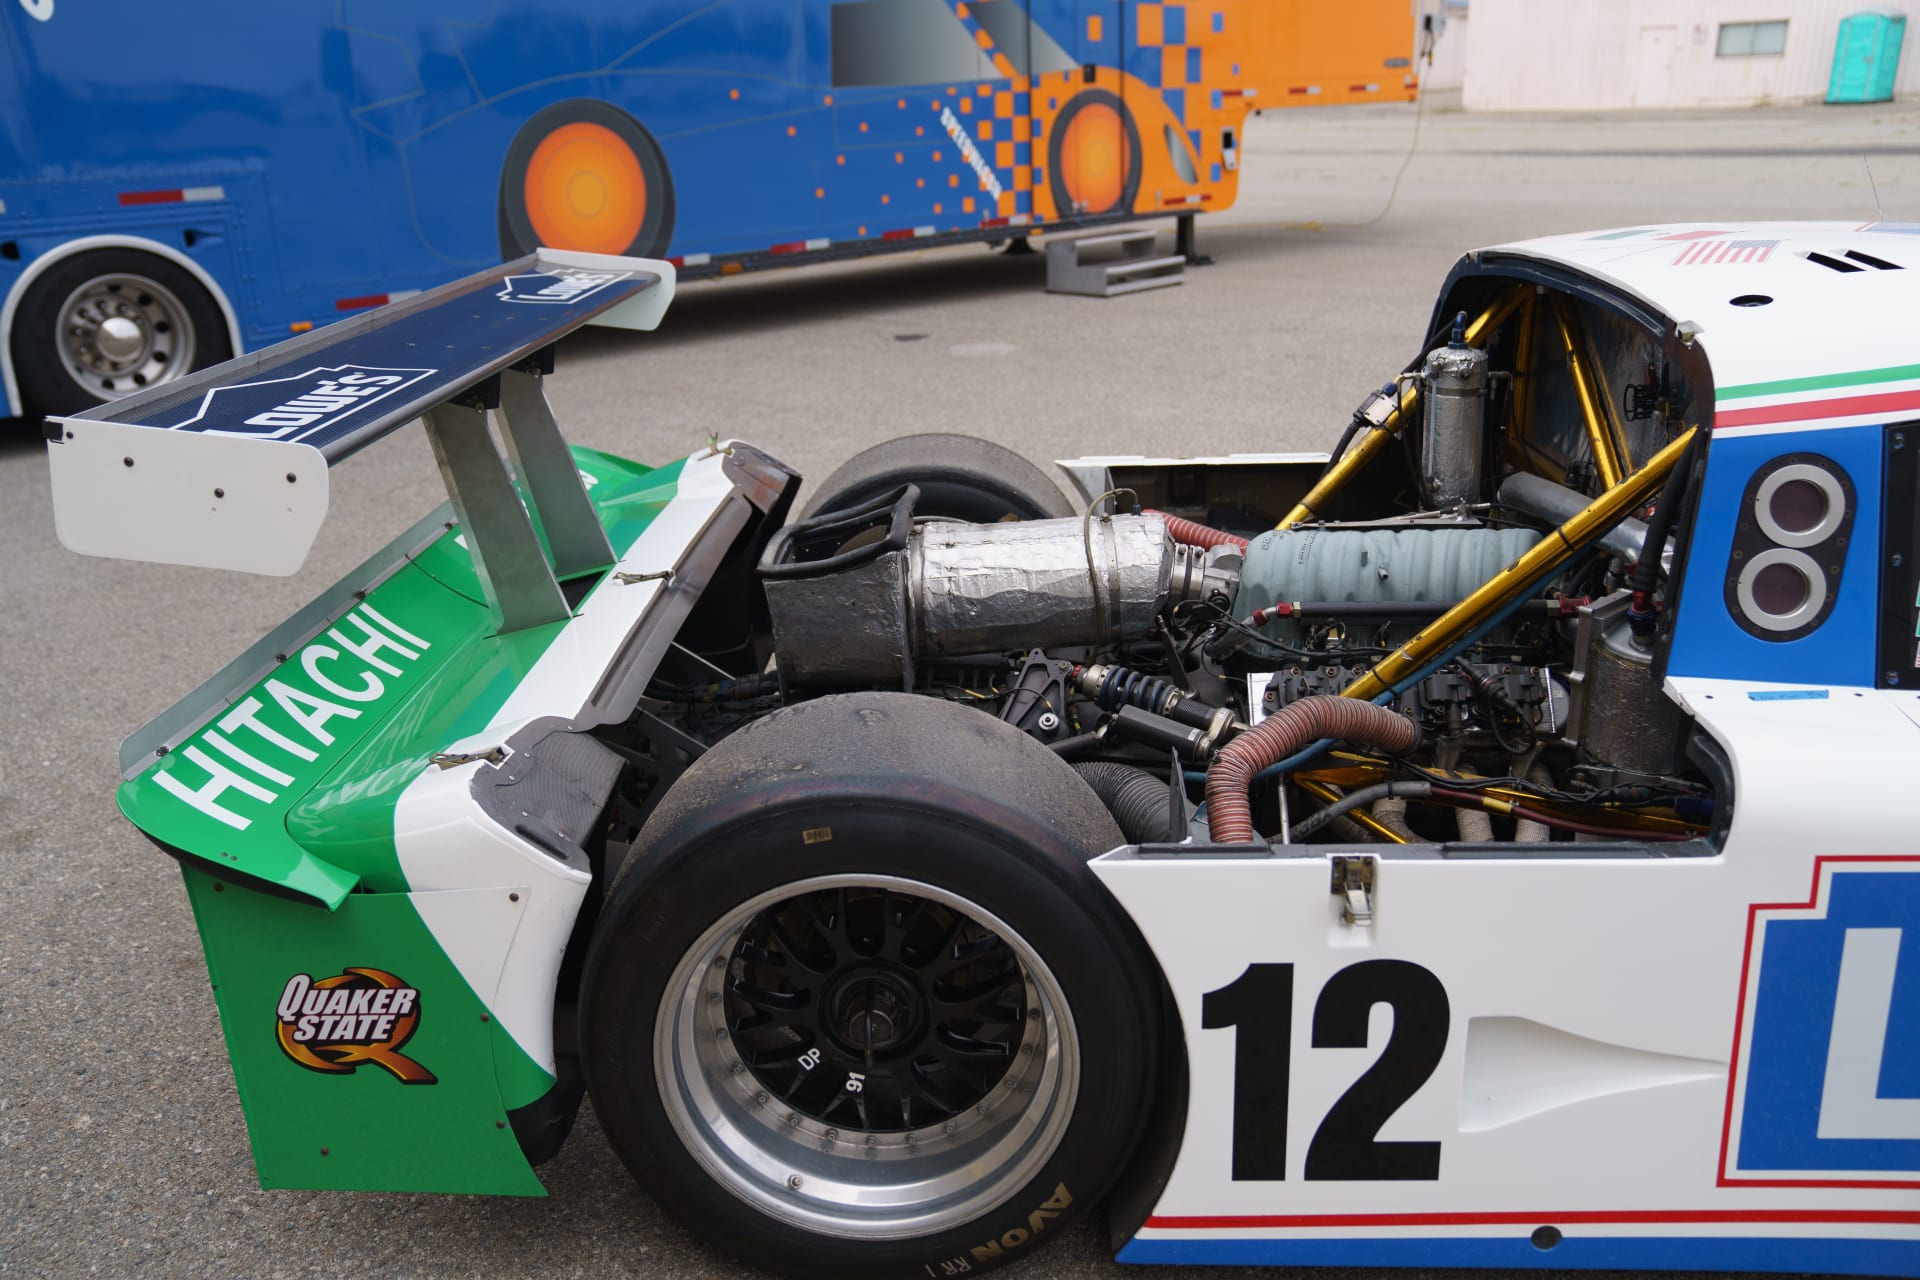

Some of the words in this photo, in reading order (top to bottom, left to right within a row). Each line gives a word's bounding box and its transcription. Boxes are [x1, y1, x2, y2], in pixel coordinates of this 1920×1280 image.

[152, 602, 431, 831] HITACHI
[278, 974, 416, 1021] QUAKER
[293, 1014, 396, 1041] STATE
[798, 1048, 820, 1071] DP
[1202, 959, 1450, 1182] 12
[970, 1181, 1073, 1263] AVON
